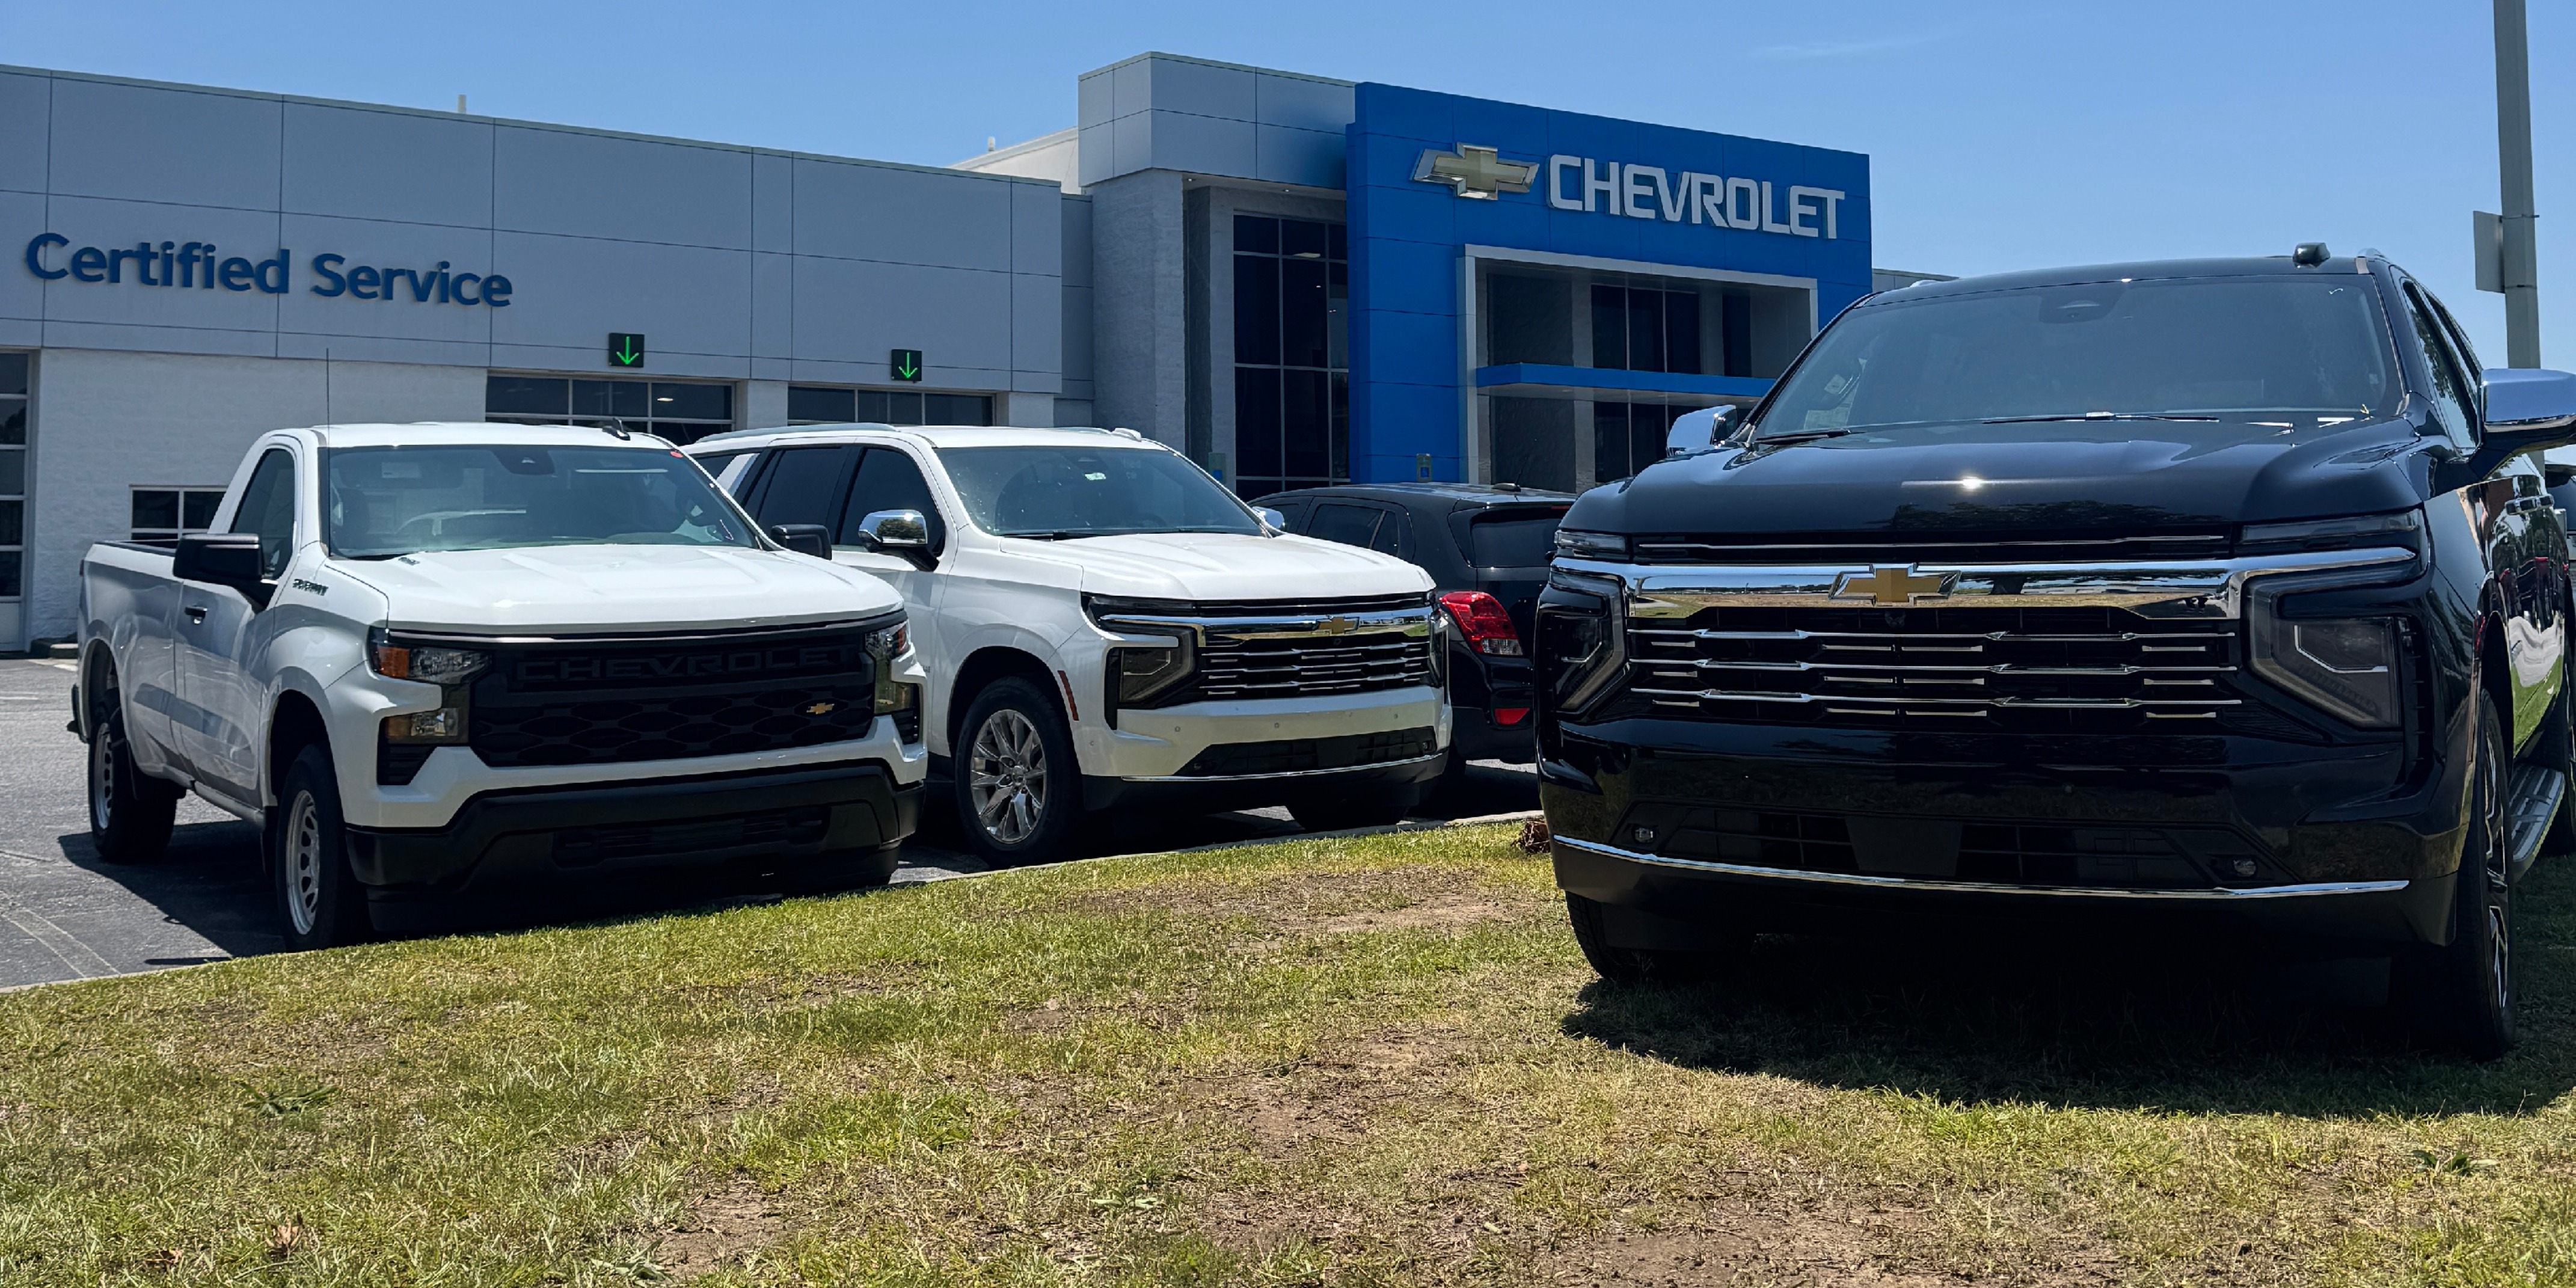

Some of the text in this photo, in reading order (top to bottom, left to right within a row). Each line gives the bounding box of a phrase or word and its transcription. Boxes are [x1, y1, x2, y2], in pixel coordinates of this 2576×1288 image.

[1547, 154, 1845, 239] CHEVROLET
[26, 232, 513, 307] Certified Service
[517, 644, 856, 681] CHEVROLET
